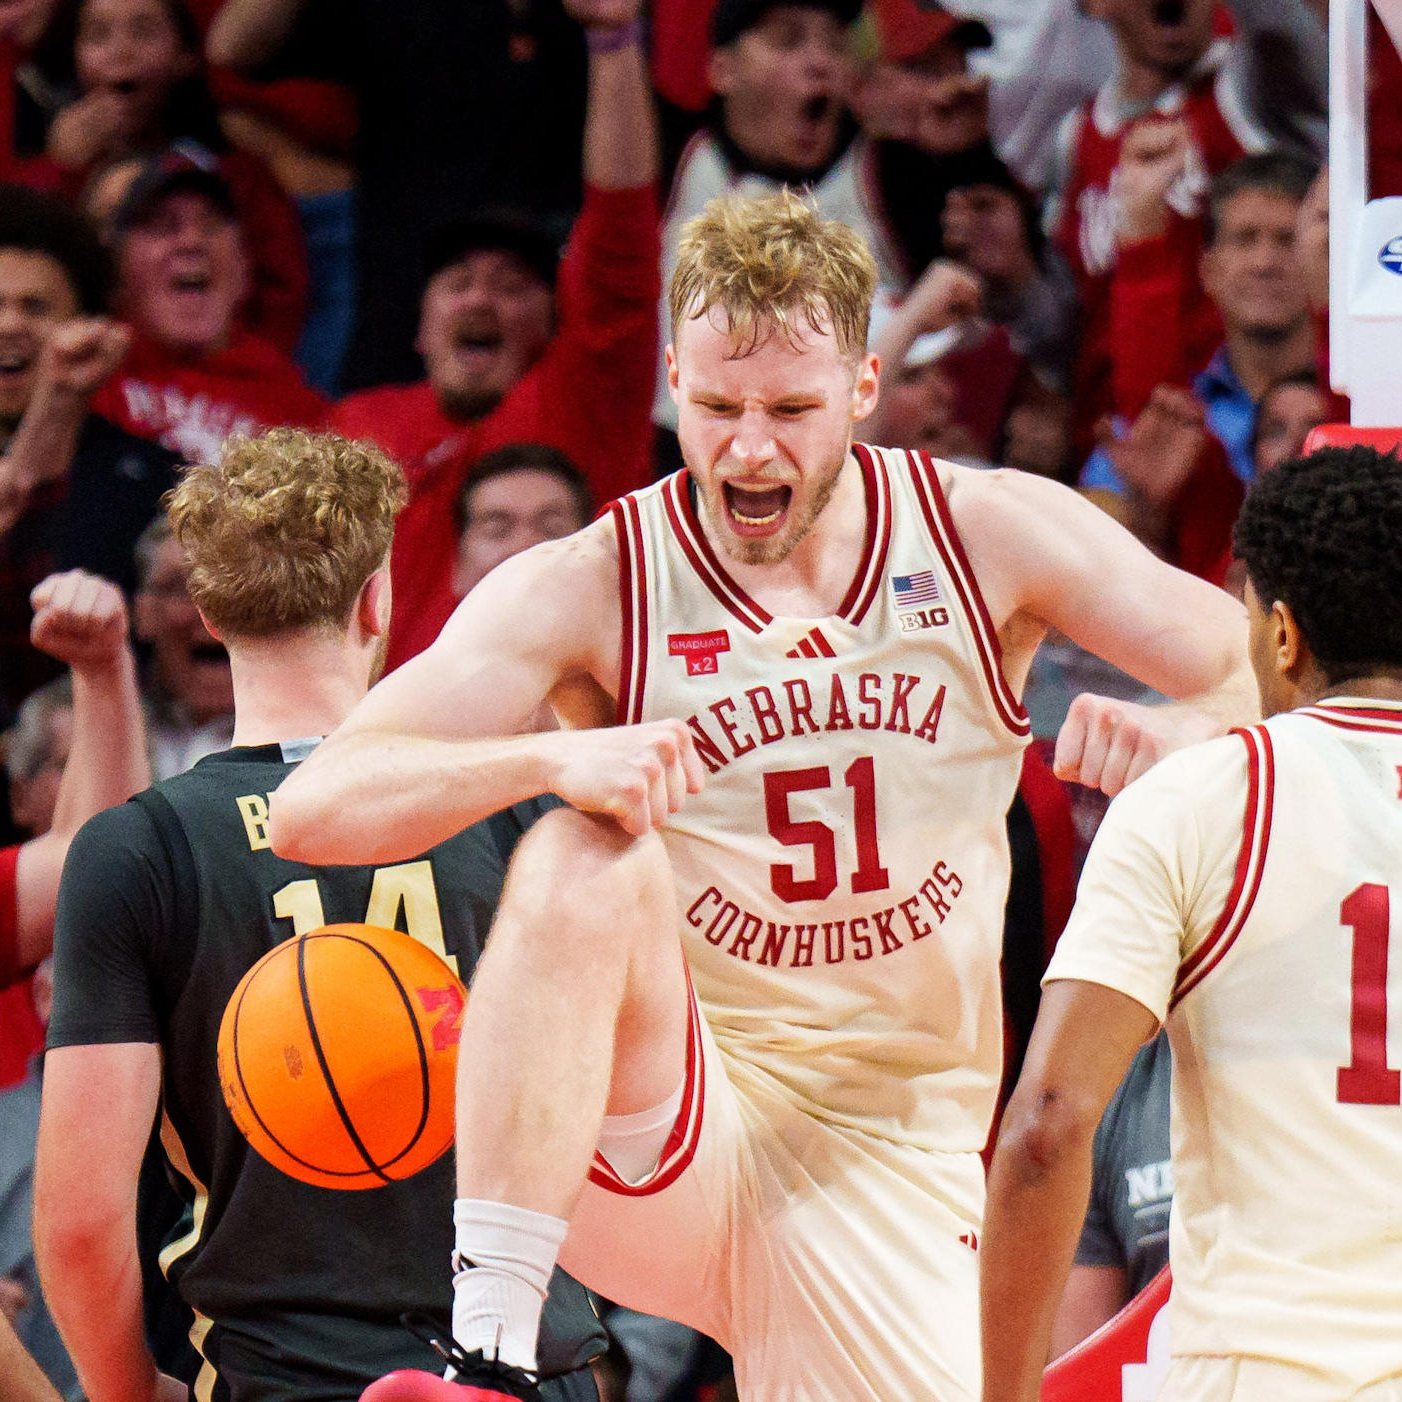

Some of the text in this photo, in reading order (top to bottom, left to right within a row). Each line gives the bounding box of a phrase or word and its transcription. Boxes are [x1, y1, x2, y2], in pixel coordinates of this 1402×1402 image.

[669, 635, 728, 651] GRADUATE
[685, 672, 947, 774] NEBRASKA
[763, 755, 890, 904] 51
[685, 860, 963, 968] CORNHUSKERS
